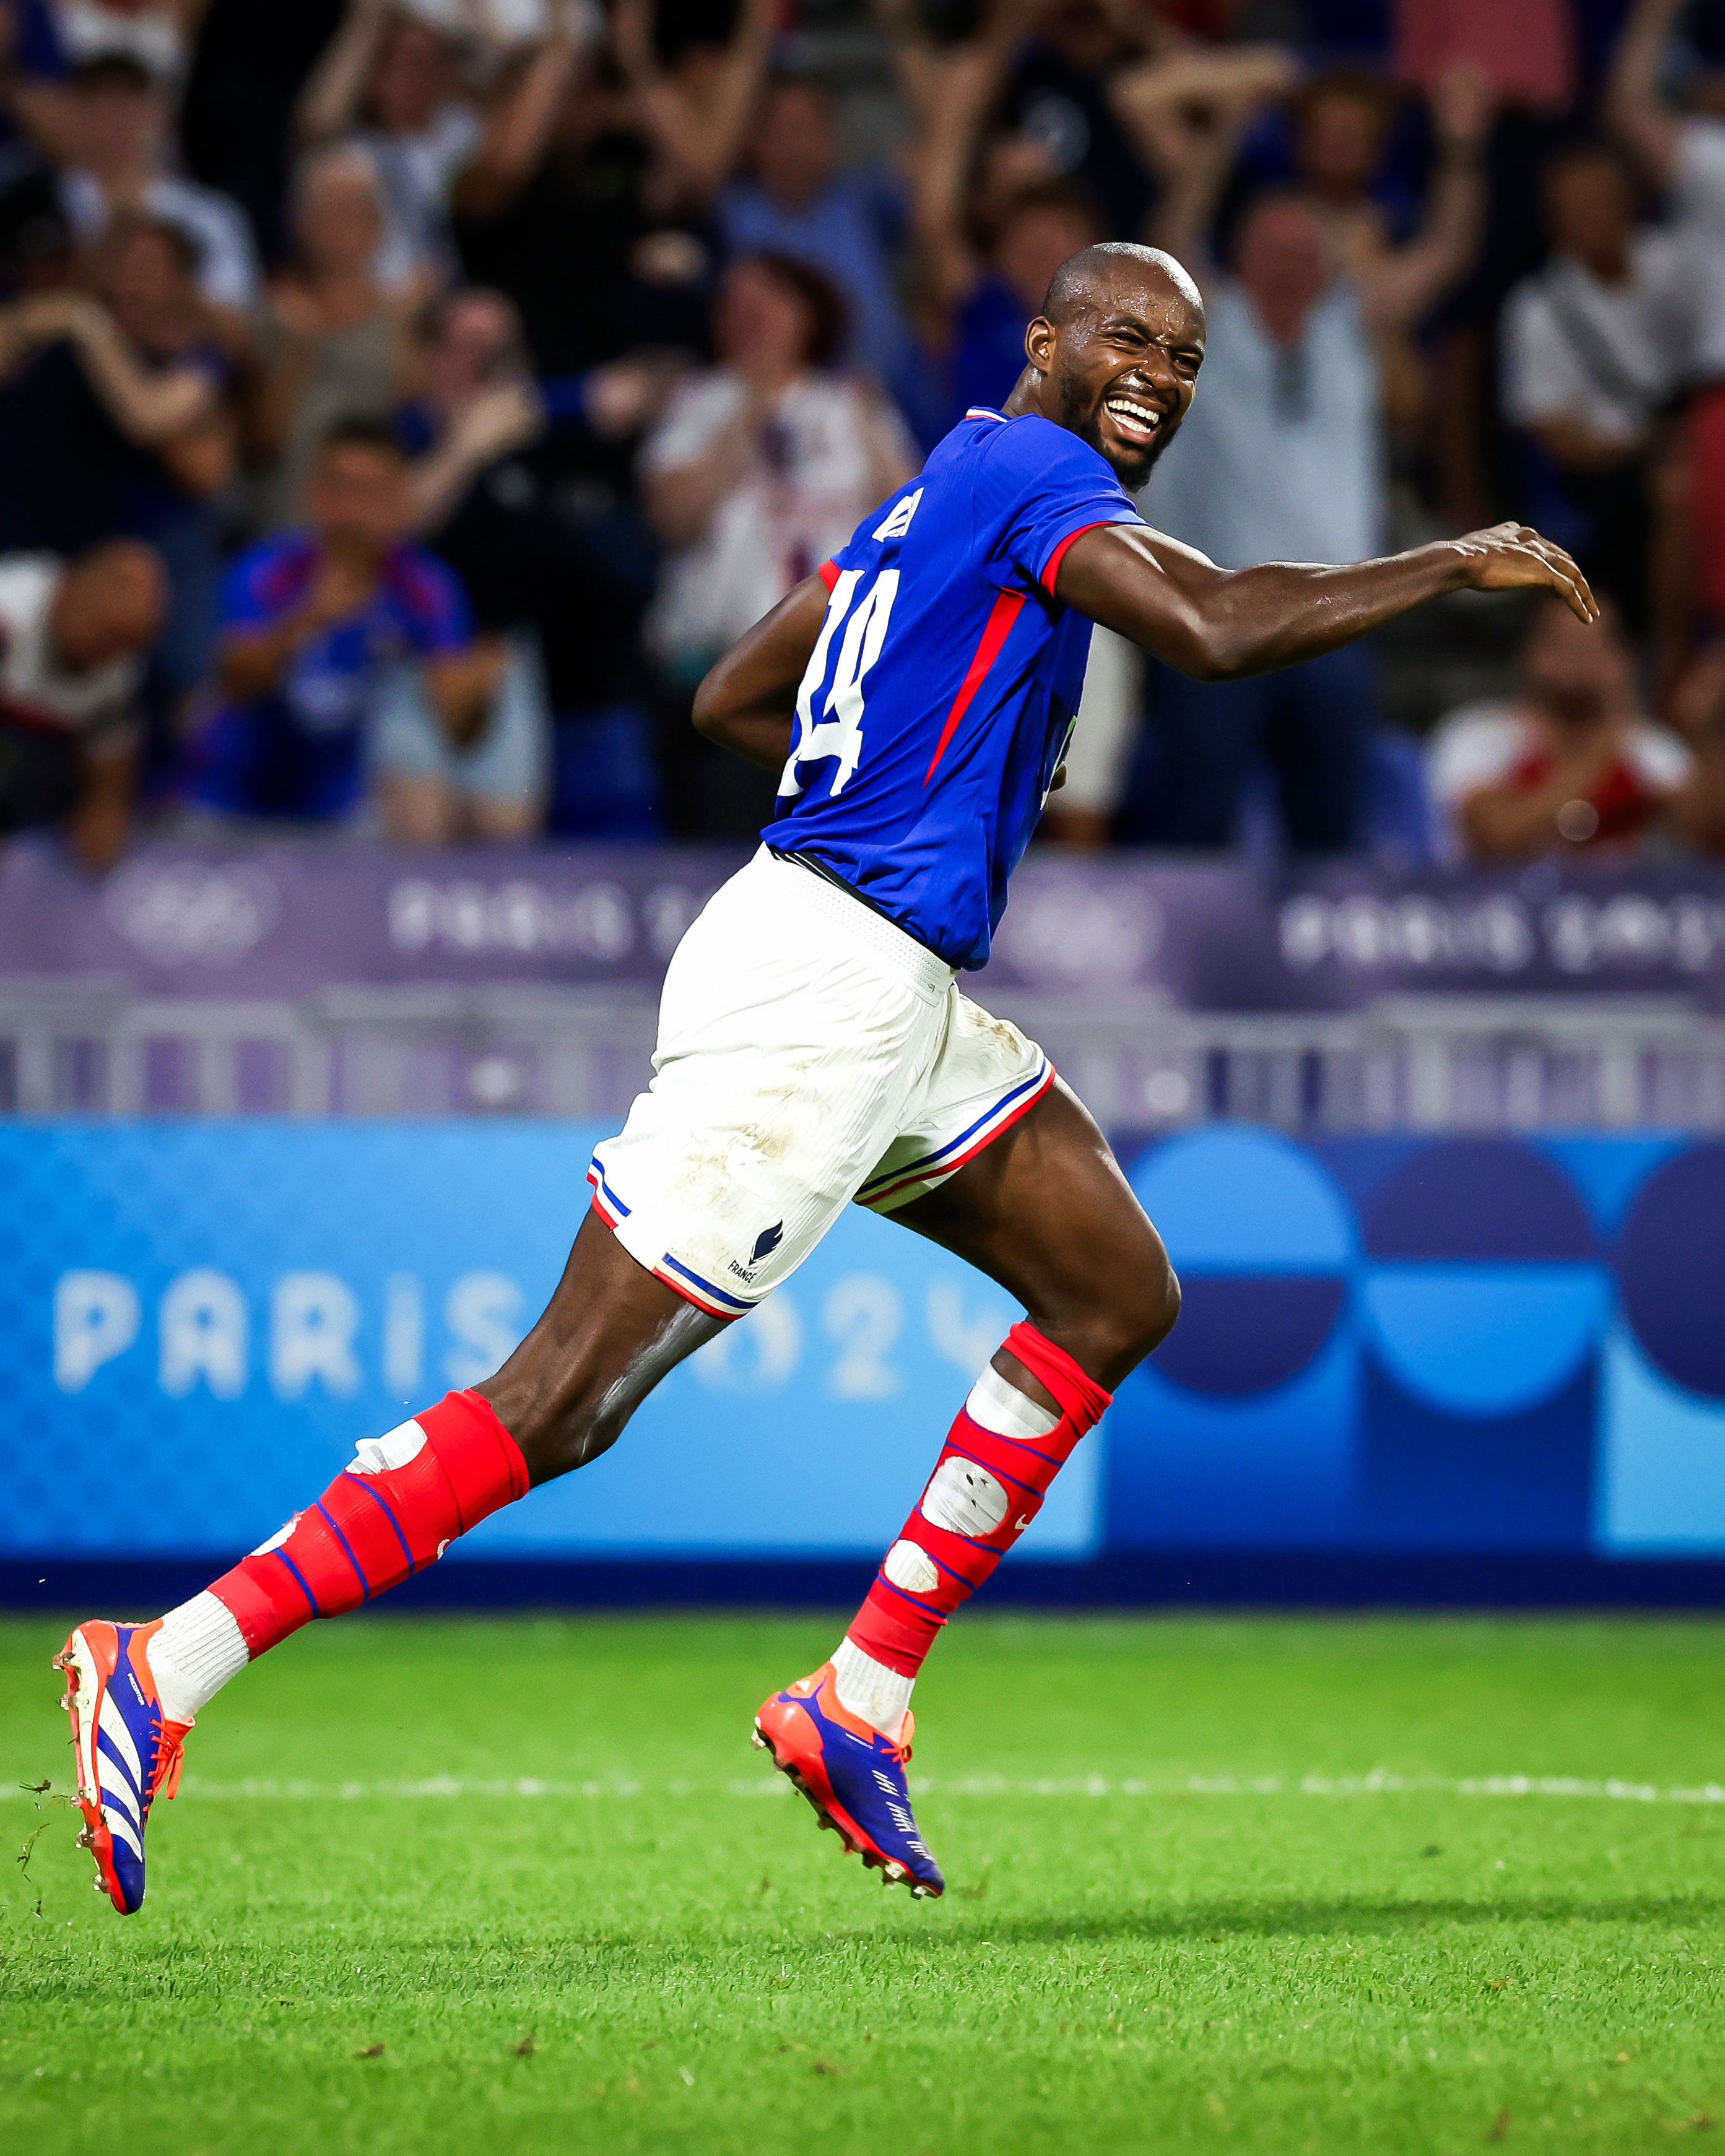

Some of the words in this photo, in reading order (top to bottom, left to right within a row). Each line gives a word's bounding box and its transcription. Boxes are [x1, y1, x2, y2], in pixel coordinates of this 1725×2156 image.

[776, 568, 901, 797] 14
[53, 1268, 526, 1400] PARIS
[728, 1259, 757, 1283] FRANCE
